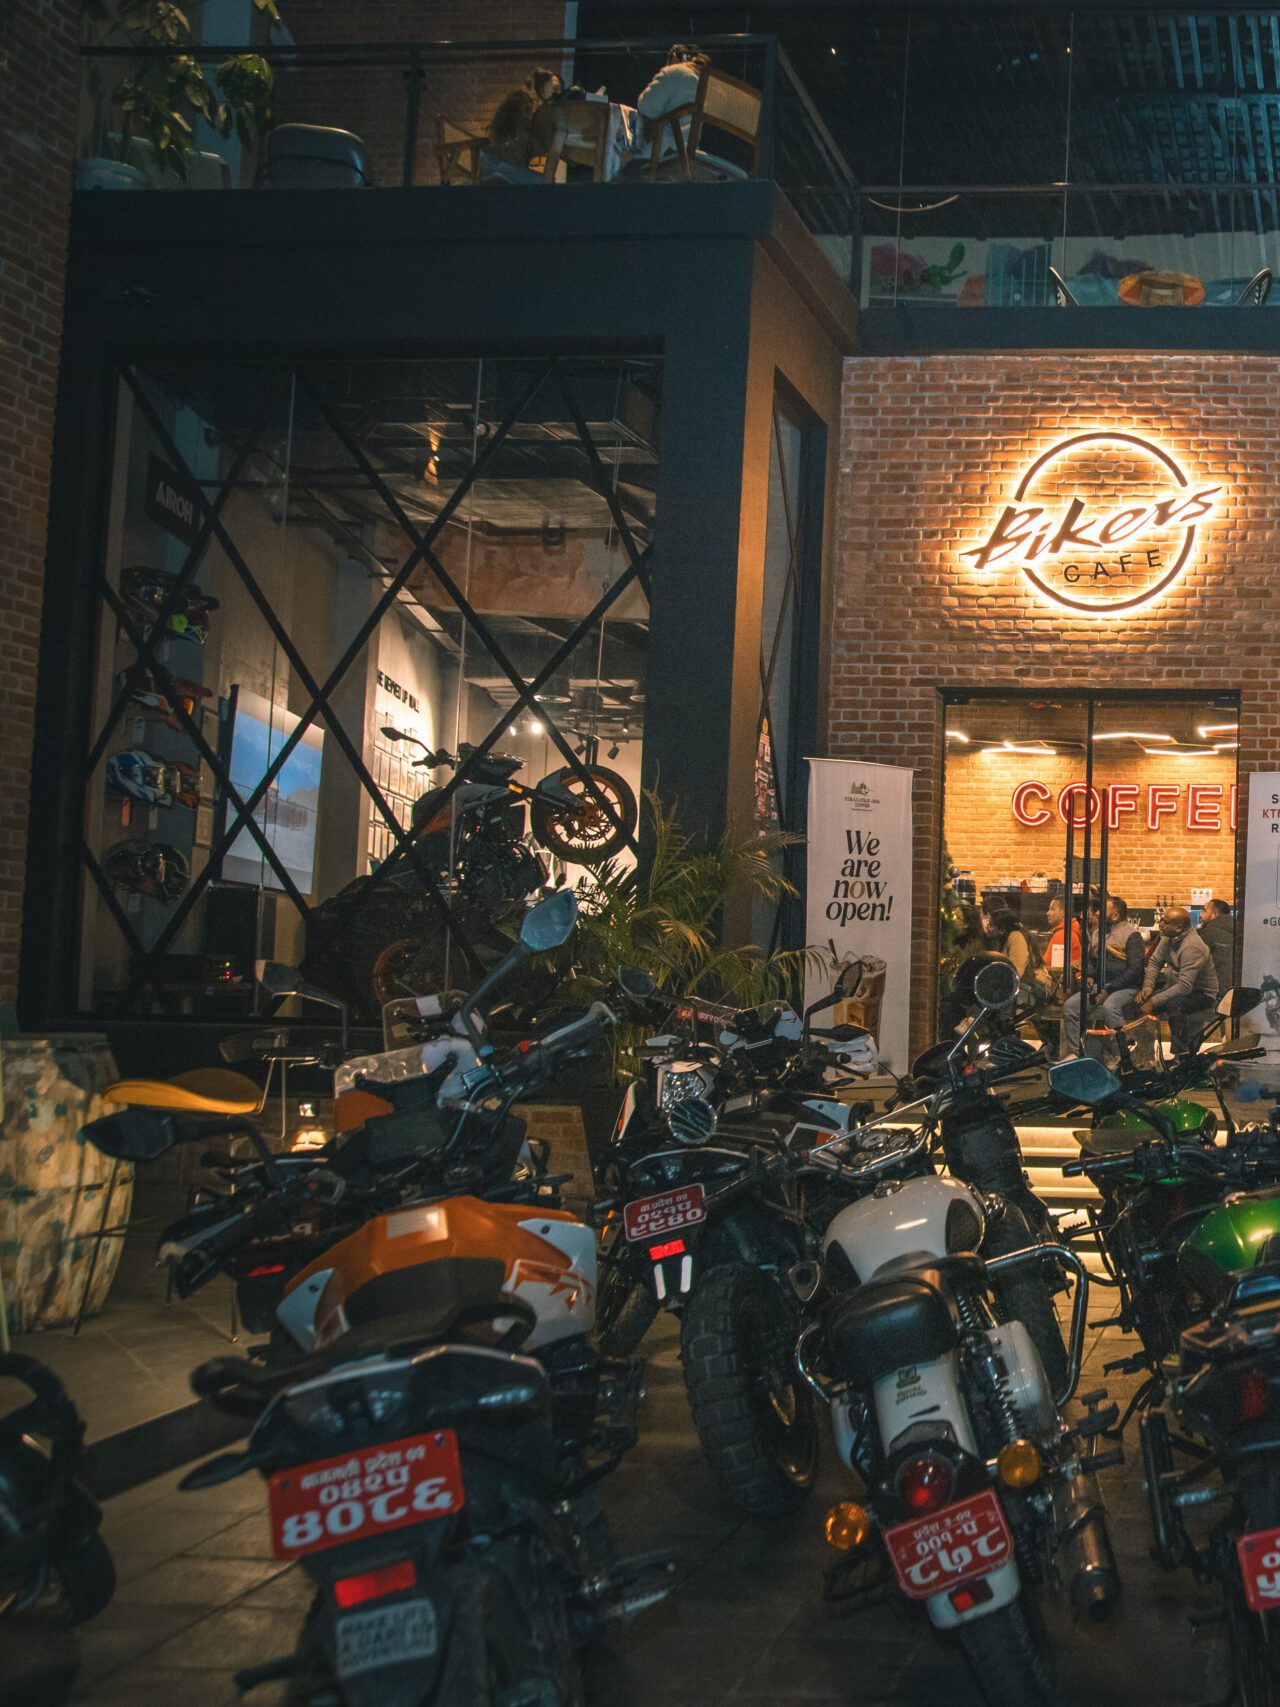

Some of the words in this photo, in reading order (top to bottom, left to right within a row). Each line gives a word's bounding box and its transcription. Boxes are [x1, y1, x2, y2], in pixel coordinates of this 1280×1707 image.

[156, 480, 193, 527] AIROH
[958, 485, 1223, 570] Bikers
[1063, 548, 1165, 584] CAFE
[1011, 779, 1238, 831] COFFE
[846, 829, 880, 856] We
[841, 858, 881, 879] are
[832, 879, 888, 900] now
[825, 895, 893, 927] open!
